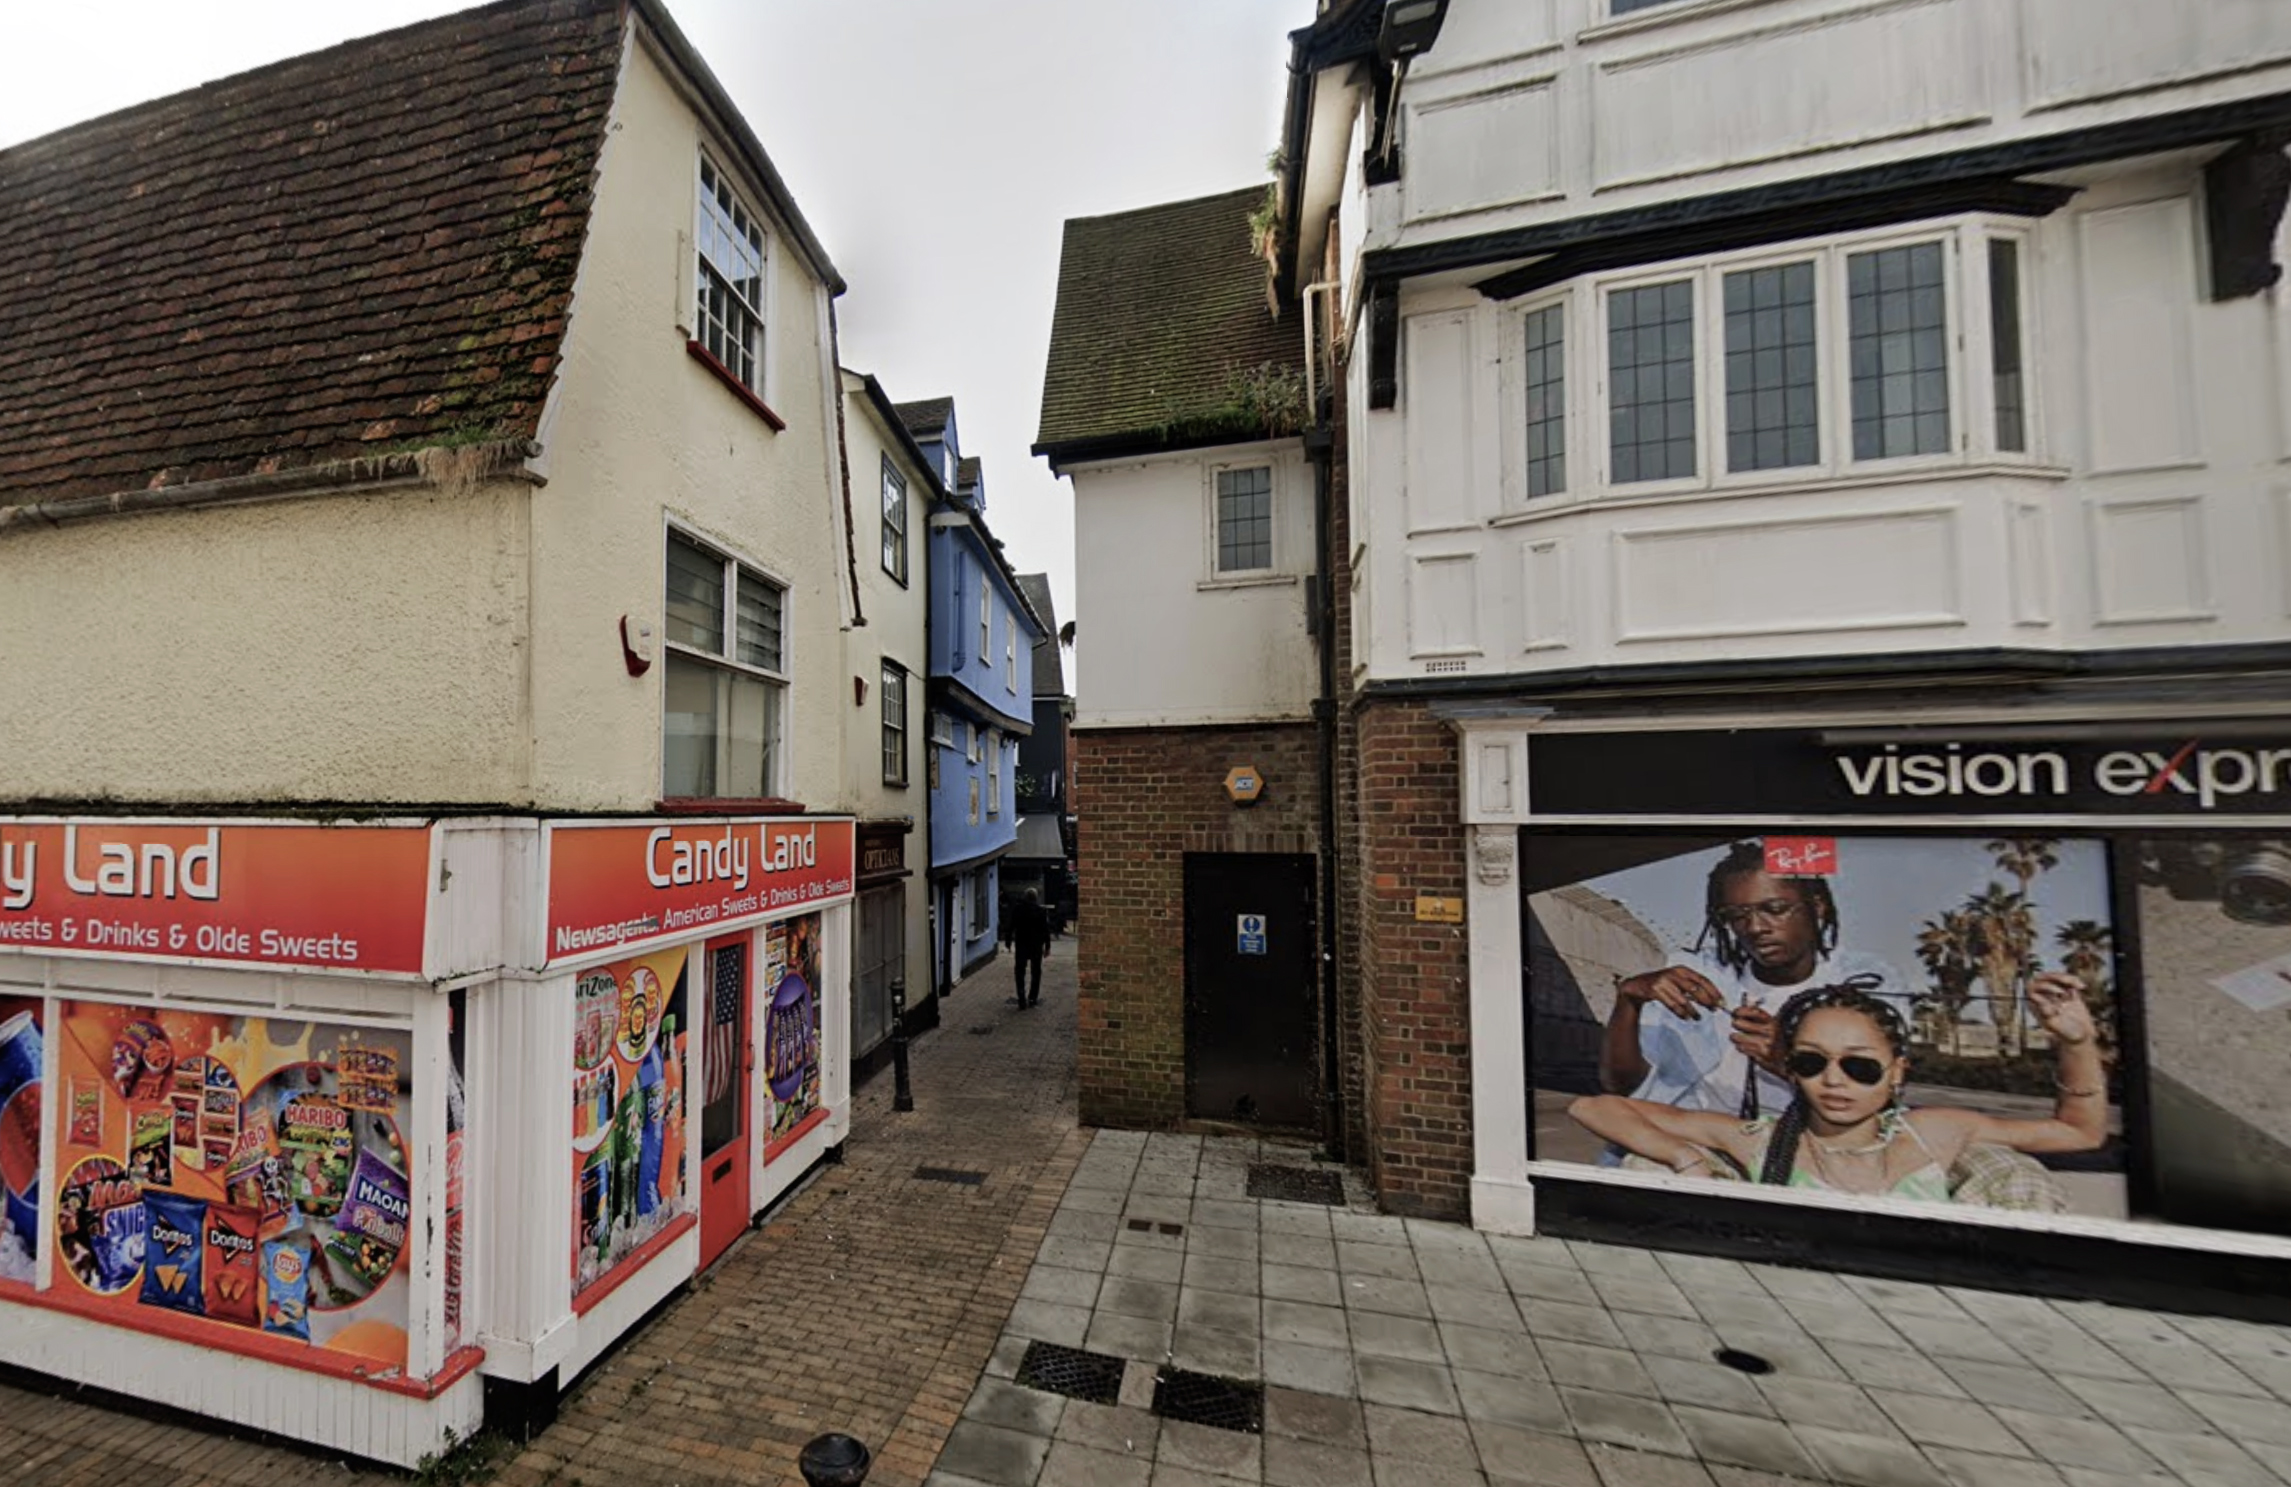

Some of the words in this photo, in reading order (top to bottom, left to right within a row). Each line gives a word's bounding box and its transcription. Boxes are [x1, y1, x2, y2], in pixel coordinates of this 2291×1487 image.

[1837, 743, 2068, 796] vision
[64, 825, 220, 900] Land
[646, 825, 749, 892] Candy
[760, 823, 815, 873] Land
[663, 902, 718, 930] American
[721, 894, 758, 917] Sweets
[760, 890, 768, 906] &
[770, 886, 798, 906] Drinks
[799, 882, 806, 899] &
[809, 880, 824, 897] Olde
[826, 876, 850, 895] Sweets
[61, 917, 79, 942] &
[86, 919, 160, 948] Drinks
[169, 923, 188, 950] &
[196, 925, 250, 954] Olde
[260, 929, 358, 961] Sweets
[285, 1104, 347, 1128] HARIBO
[152, 1225, 193, 1246] Doritos
[210, 1230, 254, 1251] Doritos
